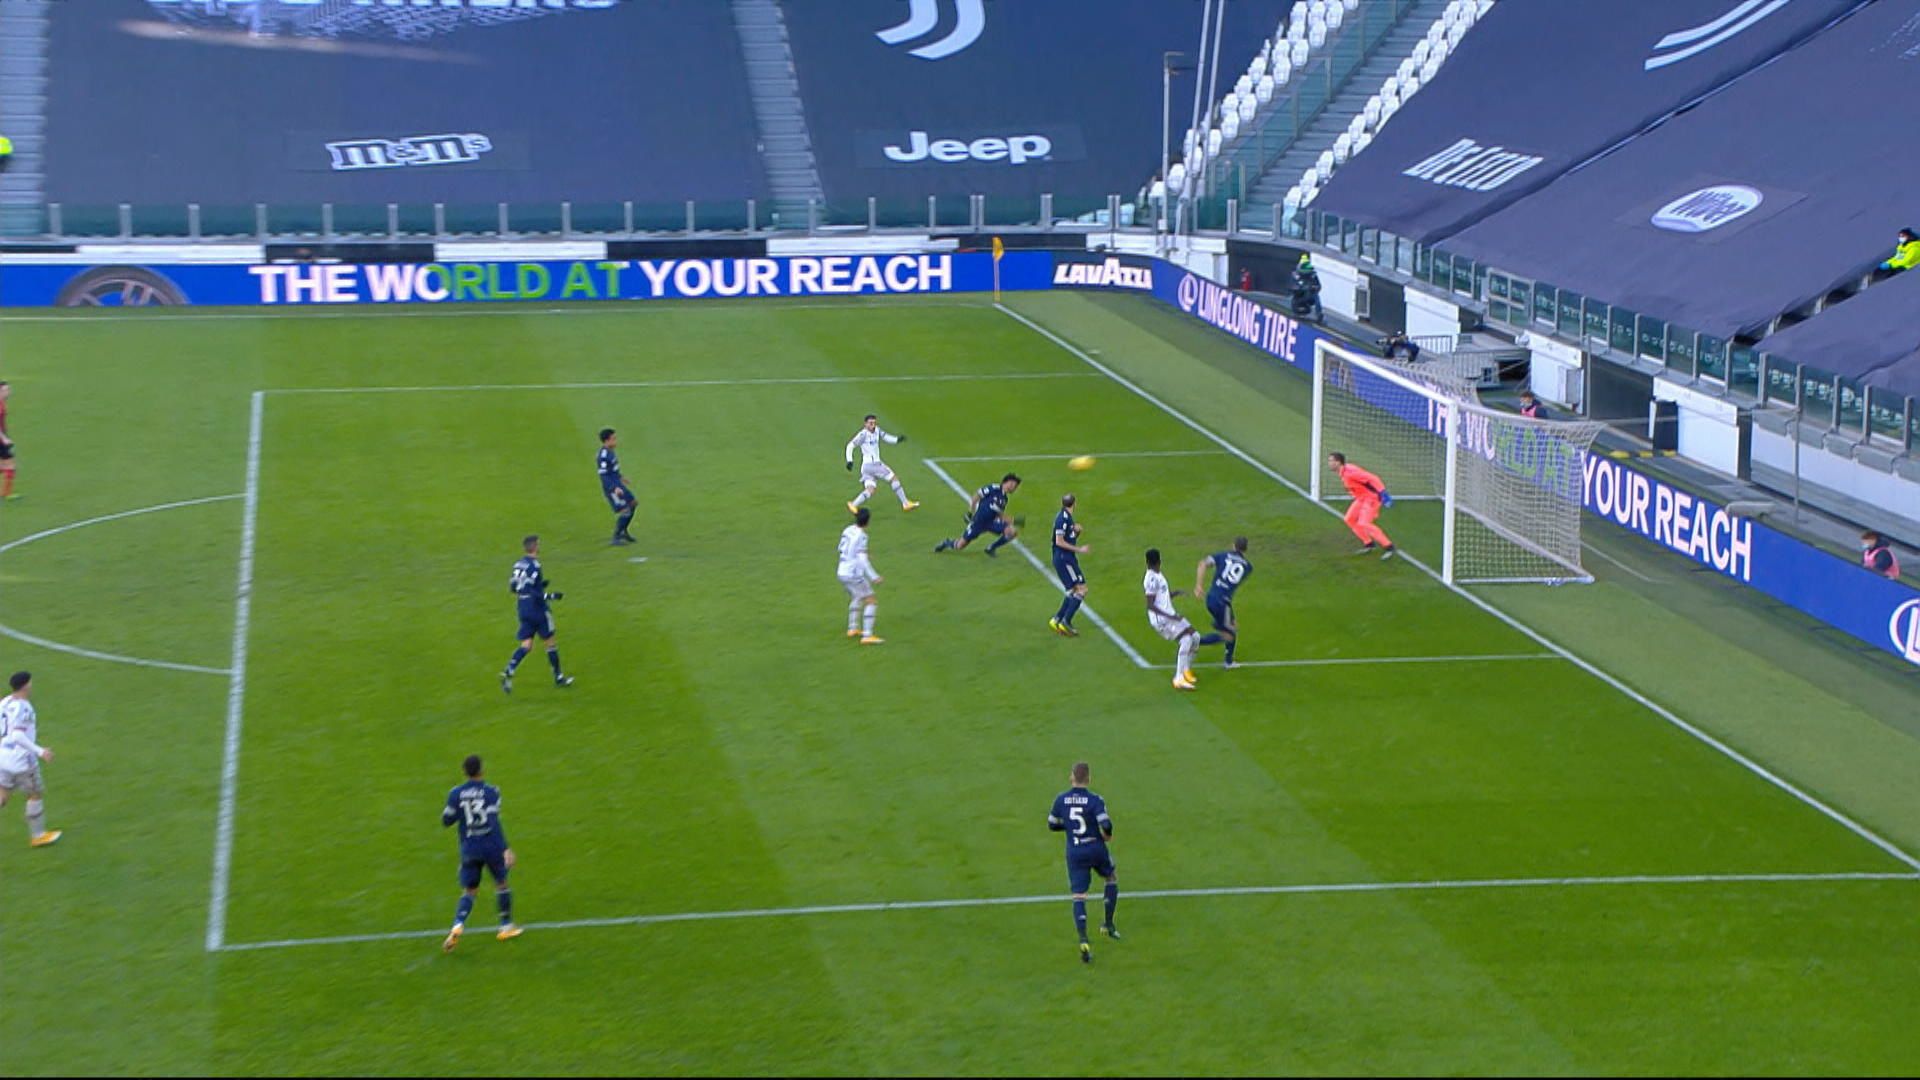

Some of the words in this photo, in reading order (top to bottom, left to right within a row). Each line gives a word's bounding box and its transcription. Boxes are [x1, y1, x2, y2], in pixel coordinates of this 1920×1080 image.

[884, 131, 1053, 164] Jeep
[248, 264, 358, 303] THE
[365, 262, 550, 301] WORLD
[560, 262, 629, 299] AT
[638, 258, 780, 297] YOUR
[789, 255, 953, 294] REACH
[1053, 256, 1153, 290] LAVAZZA
[1198, 279, 1260, 345] LINGLONG
[1263, 306, 1299, 362] TIRE
[1581, 450, 1650, 535] YOUR
[1654, 483, 1752, 582] REACH
[1222, 558, 1245, 584] 19
[460, 798, 488, 827] 13
[1069, 806, 1087, 835] 5
